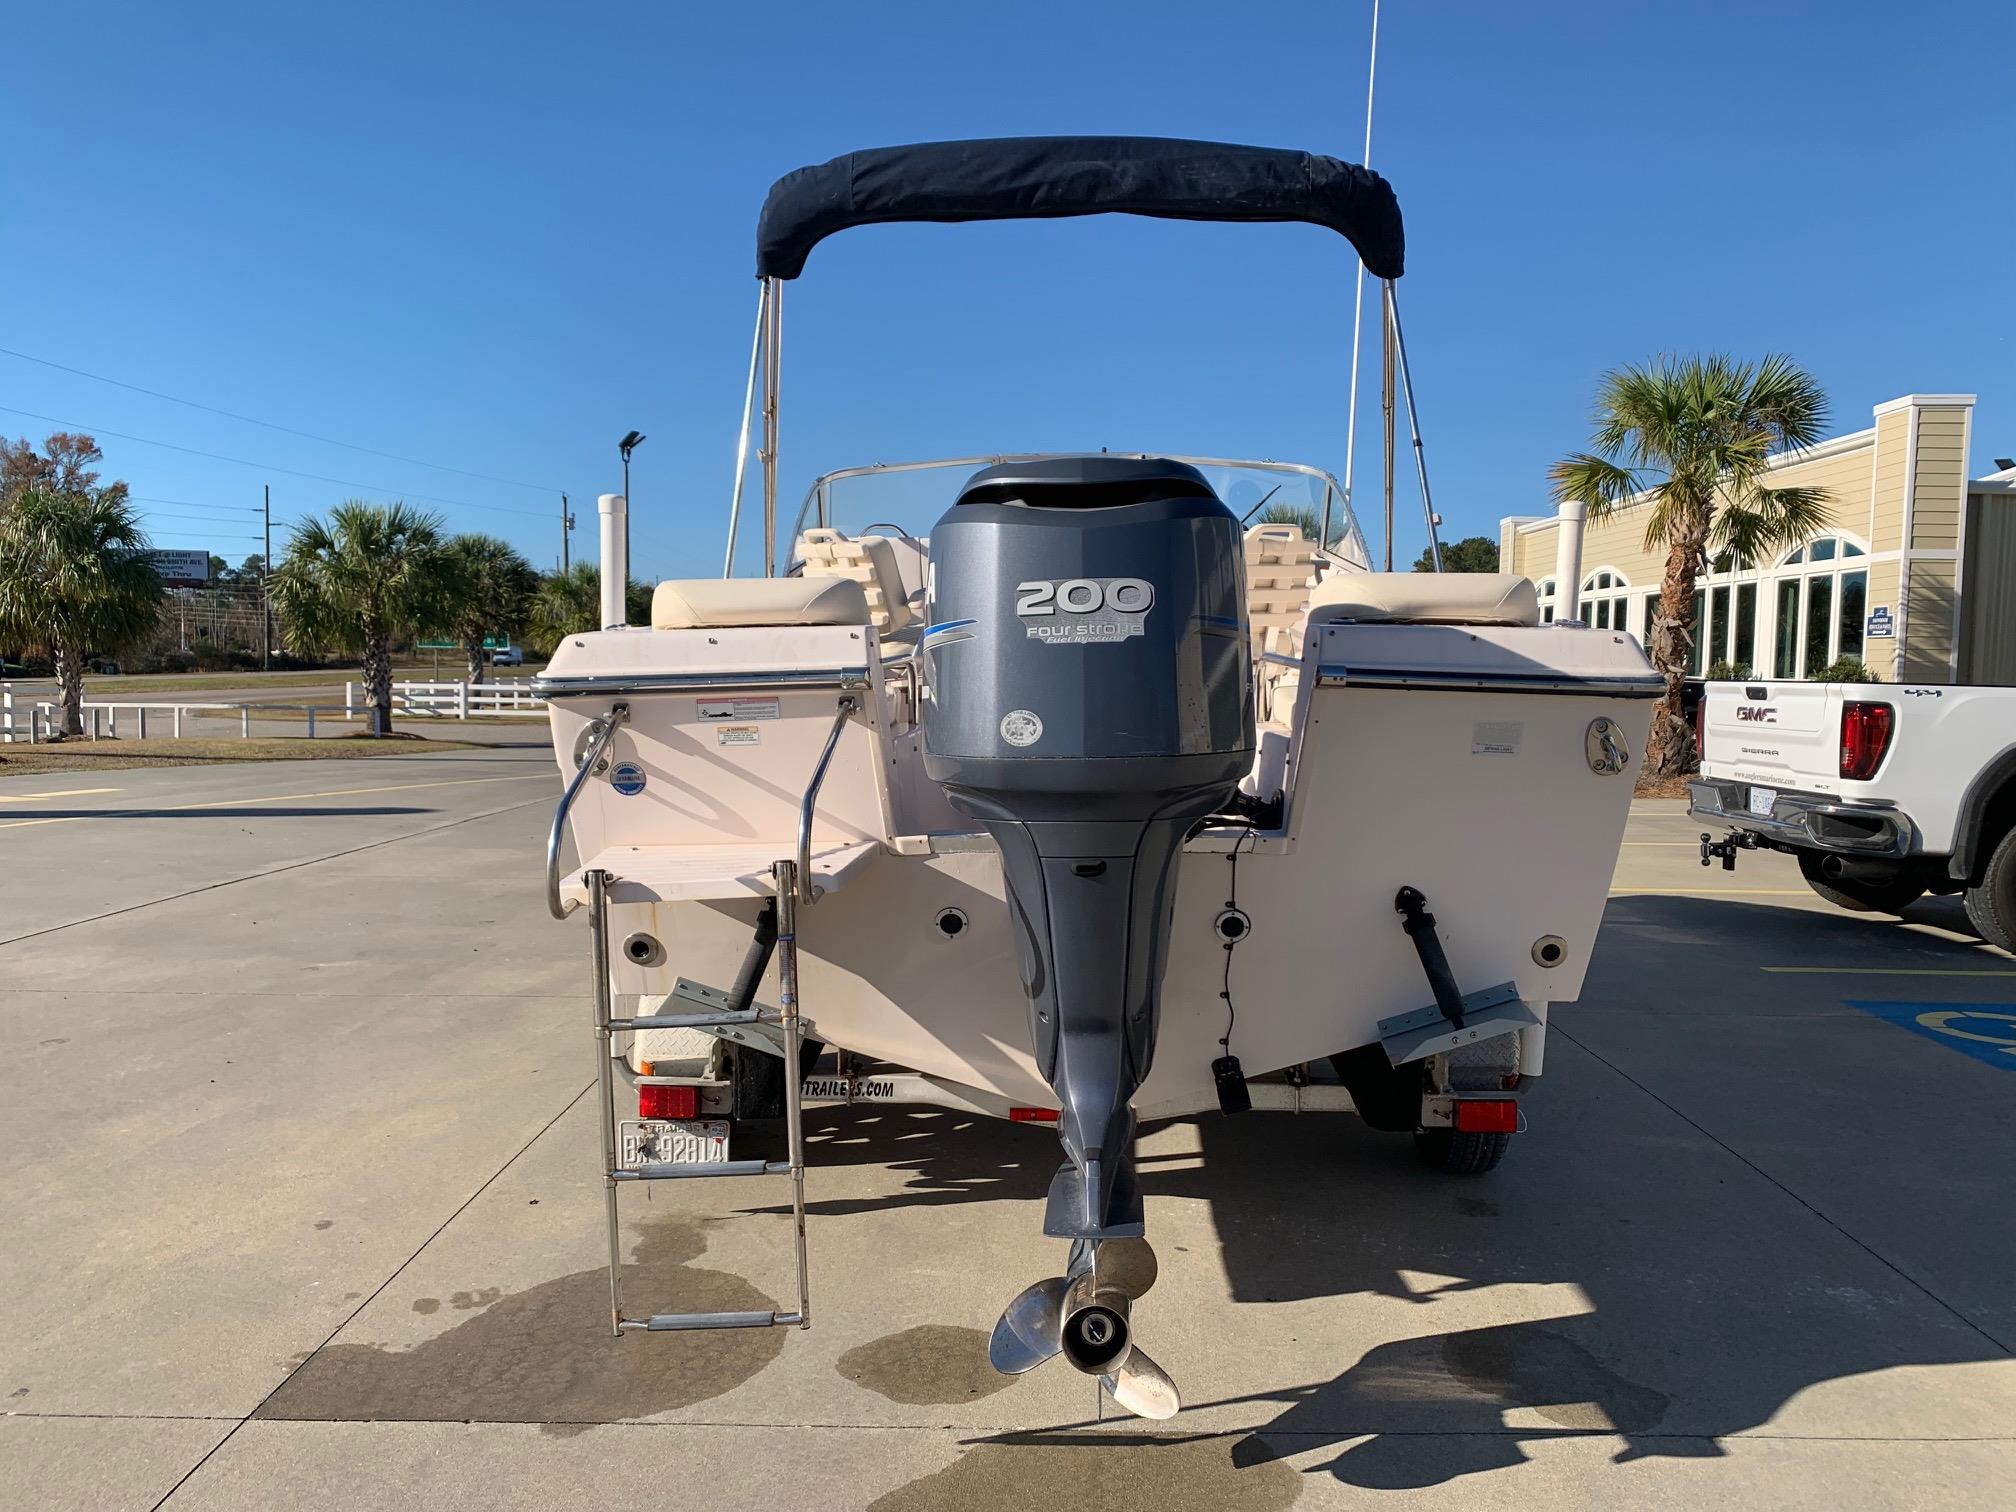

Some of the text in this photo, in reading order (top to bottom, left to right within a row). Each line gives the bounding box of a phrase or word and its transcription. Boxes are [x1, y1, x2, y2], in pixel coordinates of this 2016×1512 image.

[1016, 579, 1153, 616] 200
[1737, 707, 1777, 722] GMC
[1741, 747, 1780, 756] SIERRA
